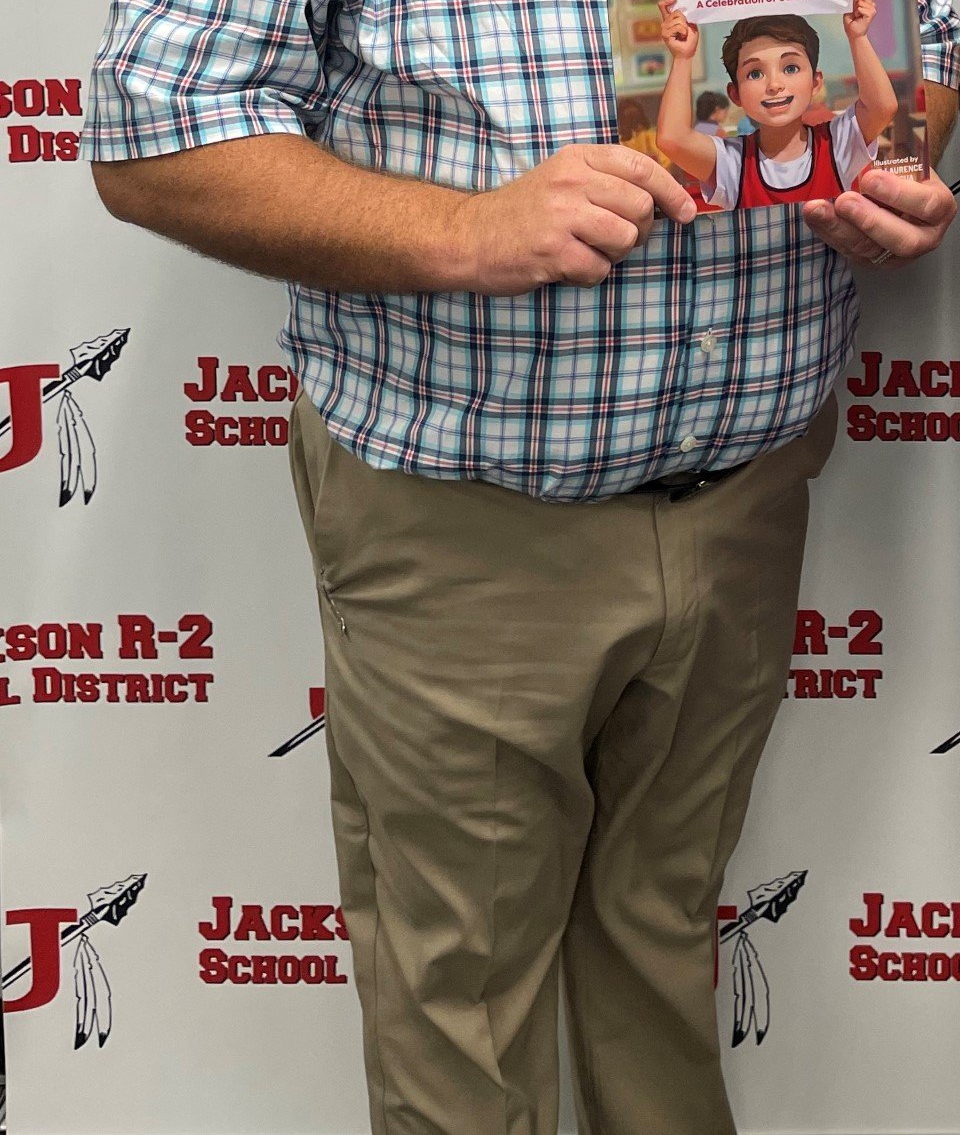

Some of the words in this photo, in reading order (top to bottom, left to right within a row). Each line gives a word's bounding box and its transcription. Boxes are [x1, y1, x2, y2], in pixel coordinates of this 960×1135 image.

[696, 0, 704, 9] A
[873, 157, 908, 166] Illustrated
[186, 410, 289, 446] SCHO
[117, 614, 213, 659] R-2
[791, 610, 882, 654] R-2
[31, 666, 214, 703] DISTRICT
[199, 897, 350, 941] JACK
[199, 949, 348, 985] SCHOOL
